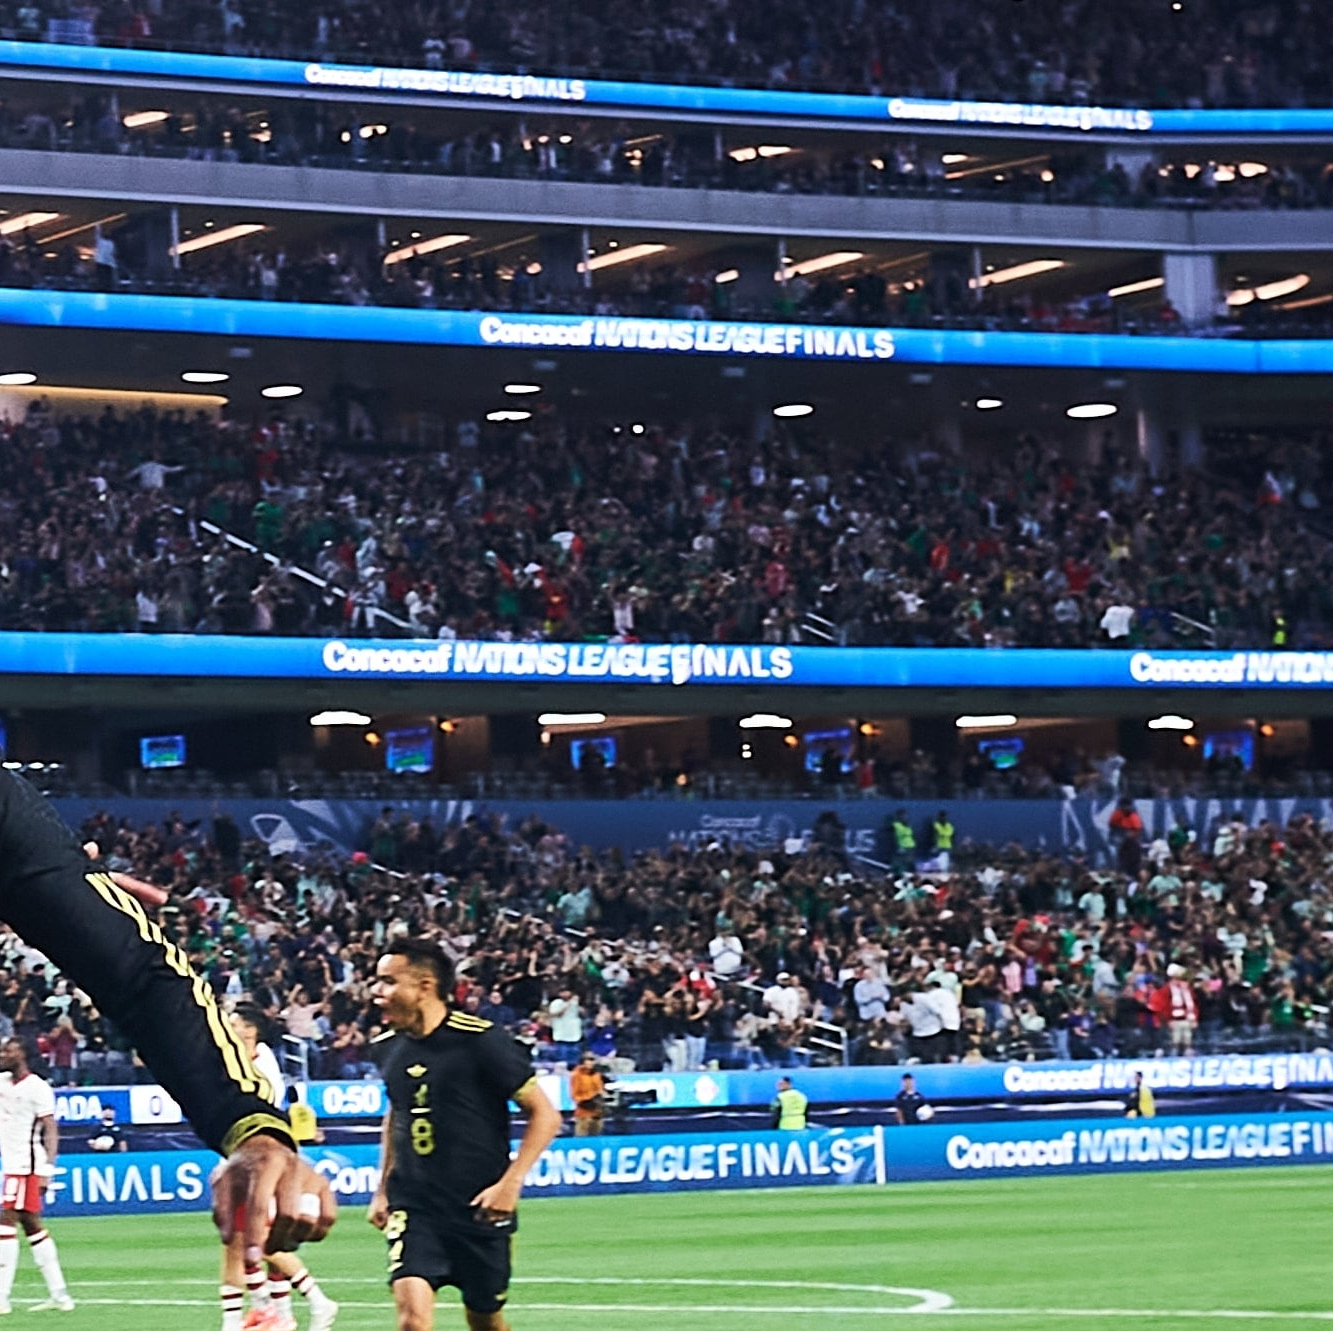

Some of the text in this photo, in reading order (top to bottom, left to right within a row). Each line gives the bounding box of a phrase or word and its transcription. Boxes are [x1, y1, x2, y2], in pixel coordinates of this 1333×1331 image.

[479, 316, 895, 359] Concacaf NATIONS LEAGUE FINALS
[323, 642, 453, 674] Concacaf
[453, 643, 566, 676] NATIONS
[567, 644, 670, 677] LEAGUE
[1130, 652, 1246, 683] Concacaf
[1003, 1064, 1103, 1092] Concacaf
[322, 1085, 381, 1115] 0:50
[410, 1117, 435, 1156] 8
[945, 1130, 1076, 1170] Concacaf
[1078, 1125, 1190, 1164] NATIONS
[1192, 1123, 1292, 1160] LEAGUE
[599, 1143, 716, 1184] LEAGUE
[717, 1138, 855, 1179] FINALS
